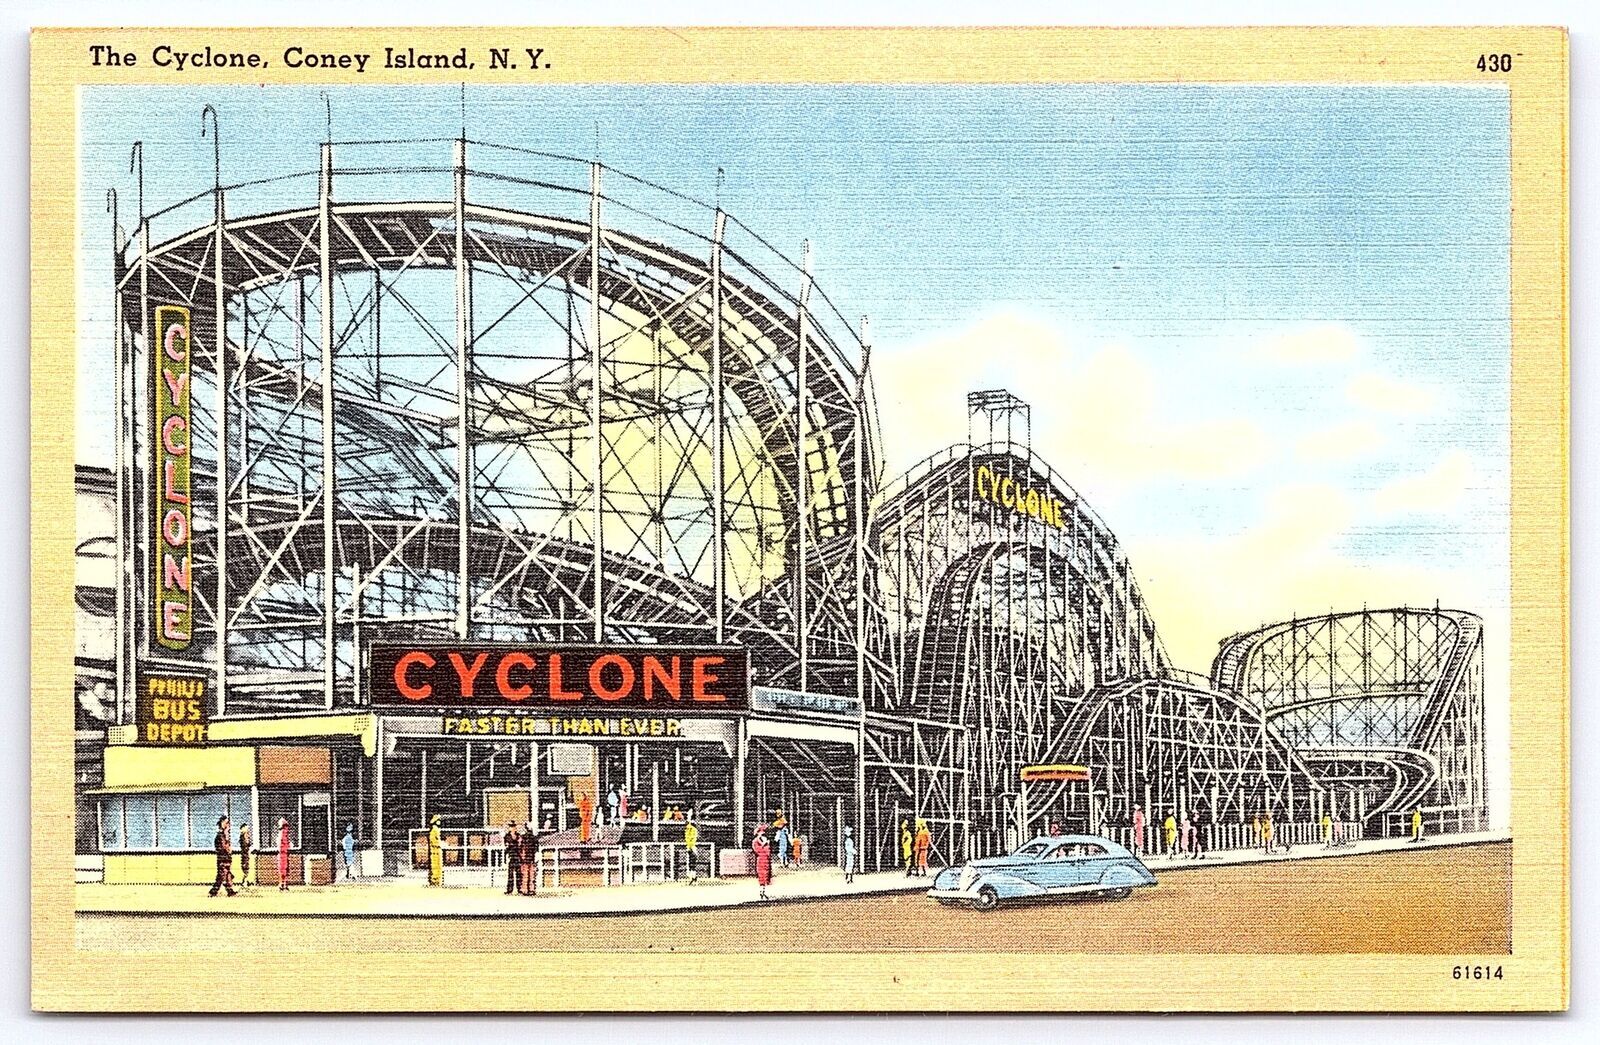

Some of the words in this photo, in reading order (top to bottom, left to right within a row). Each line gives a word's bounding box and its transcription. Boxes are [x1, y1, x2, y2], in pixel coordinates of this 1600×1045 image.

[90, 46, 136, 66] The
[153, 46, 268, 70] Cyclone,
[284, 47, 370, 72] Coney
[385, 48, 474, 70] Island,
[490, 49, 516, 69] N.
[526, 49, 551, 69] Y.
[1476, 53, 1512, 72] 430
[163, 323, 192, 641] CYCLONE
[977, 465, 1068, 532] CYCLONE
[393, 651, 726, 703] CYCLONE
[153, 699, 200, 721] BUS
[147, 722, 205, 742] DEPOT
[443, 717, 536, 735] FASTER
[549, 717, 611, 736] THAN
[619, 717, 681, 736] EVER
[1452, 965, 1504, 980] 61614
